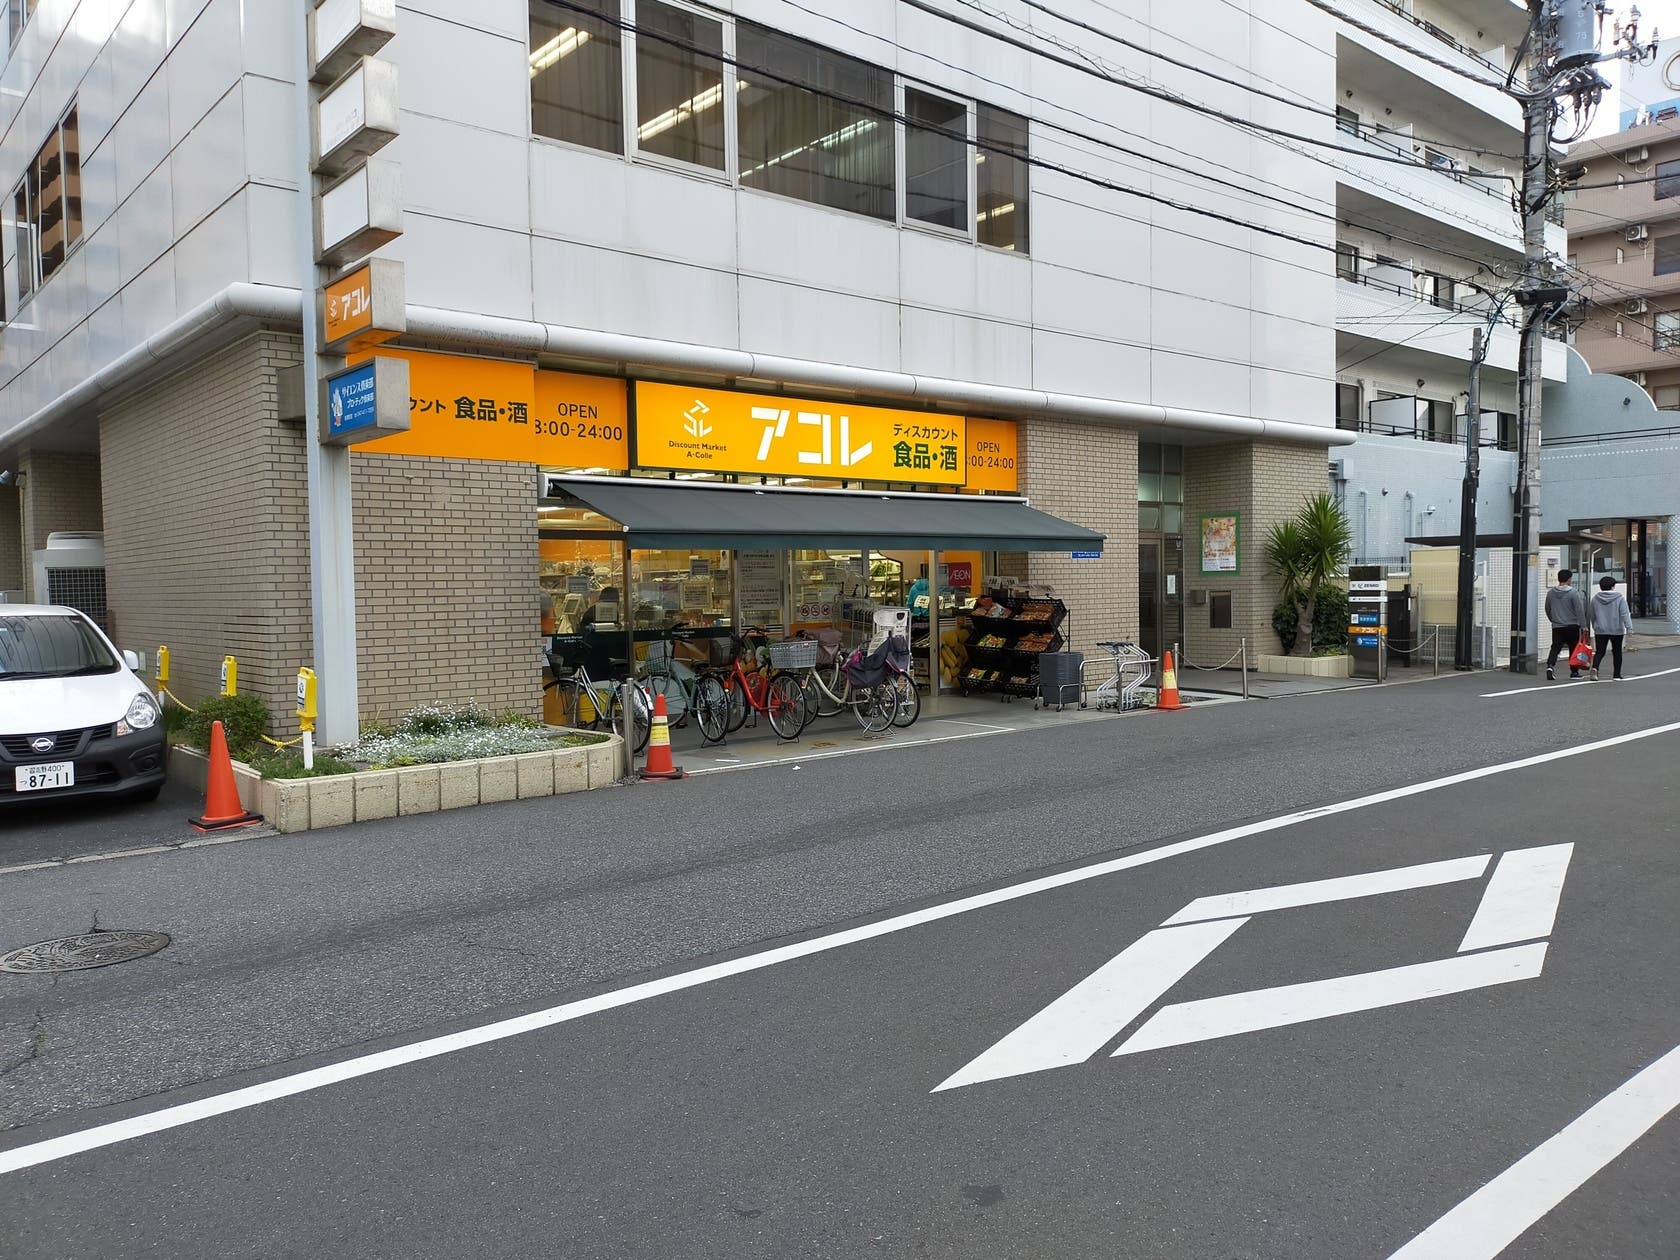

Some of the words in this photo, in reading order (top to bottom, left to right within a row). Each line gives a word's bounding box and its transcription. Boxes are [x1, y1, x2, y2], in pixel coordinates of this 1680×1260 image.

[341, 286, 371, 321] アコレ
[454, 396, 528, 425] 食品・酒
[558, 402, 598, 419] OPEN
[751, 406, 873, 466] アコレ
[893, 423, 958, 441] ディスカウント
[668, 440, 700, 450] Discount
[701, 443, 727, 452] Market
[976, 441, 1000, 453] OPEN
[893, 440, 958, 471] 食品・酒
[29, 771, 69, 788] 87-11
